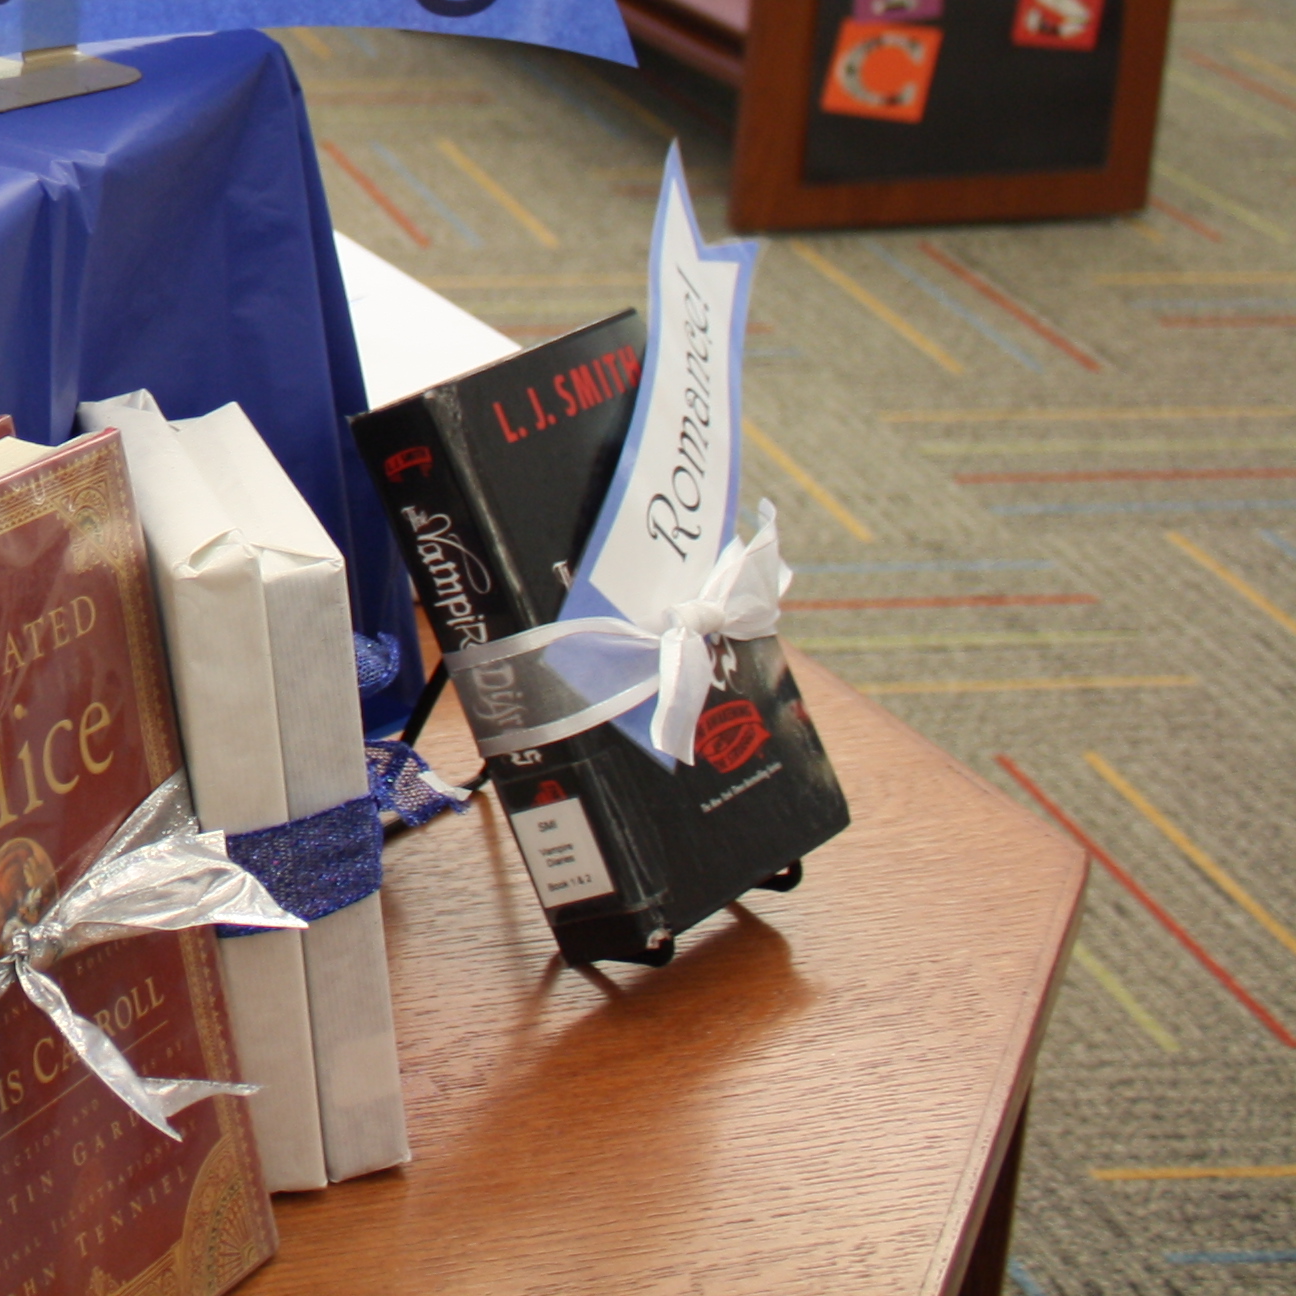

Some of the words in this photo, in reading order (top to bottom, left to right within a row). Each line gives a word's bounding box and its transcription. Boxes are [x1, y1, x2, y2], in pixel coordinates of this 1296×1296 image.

[492, 401, 529, 443] L.
[526, 387, 557, 431] J.
[553, 344, 642, 417] SMITH
[647, 263, 713, 563] Romance!
[32, 975, 165, 1084] CAROLL
[71, 1098, 101, 1125] AND
[74, 1165, 187, 1259] TENNIEL
